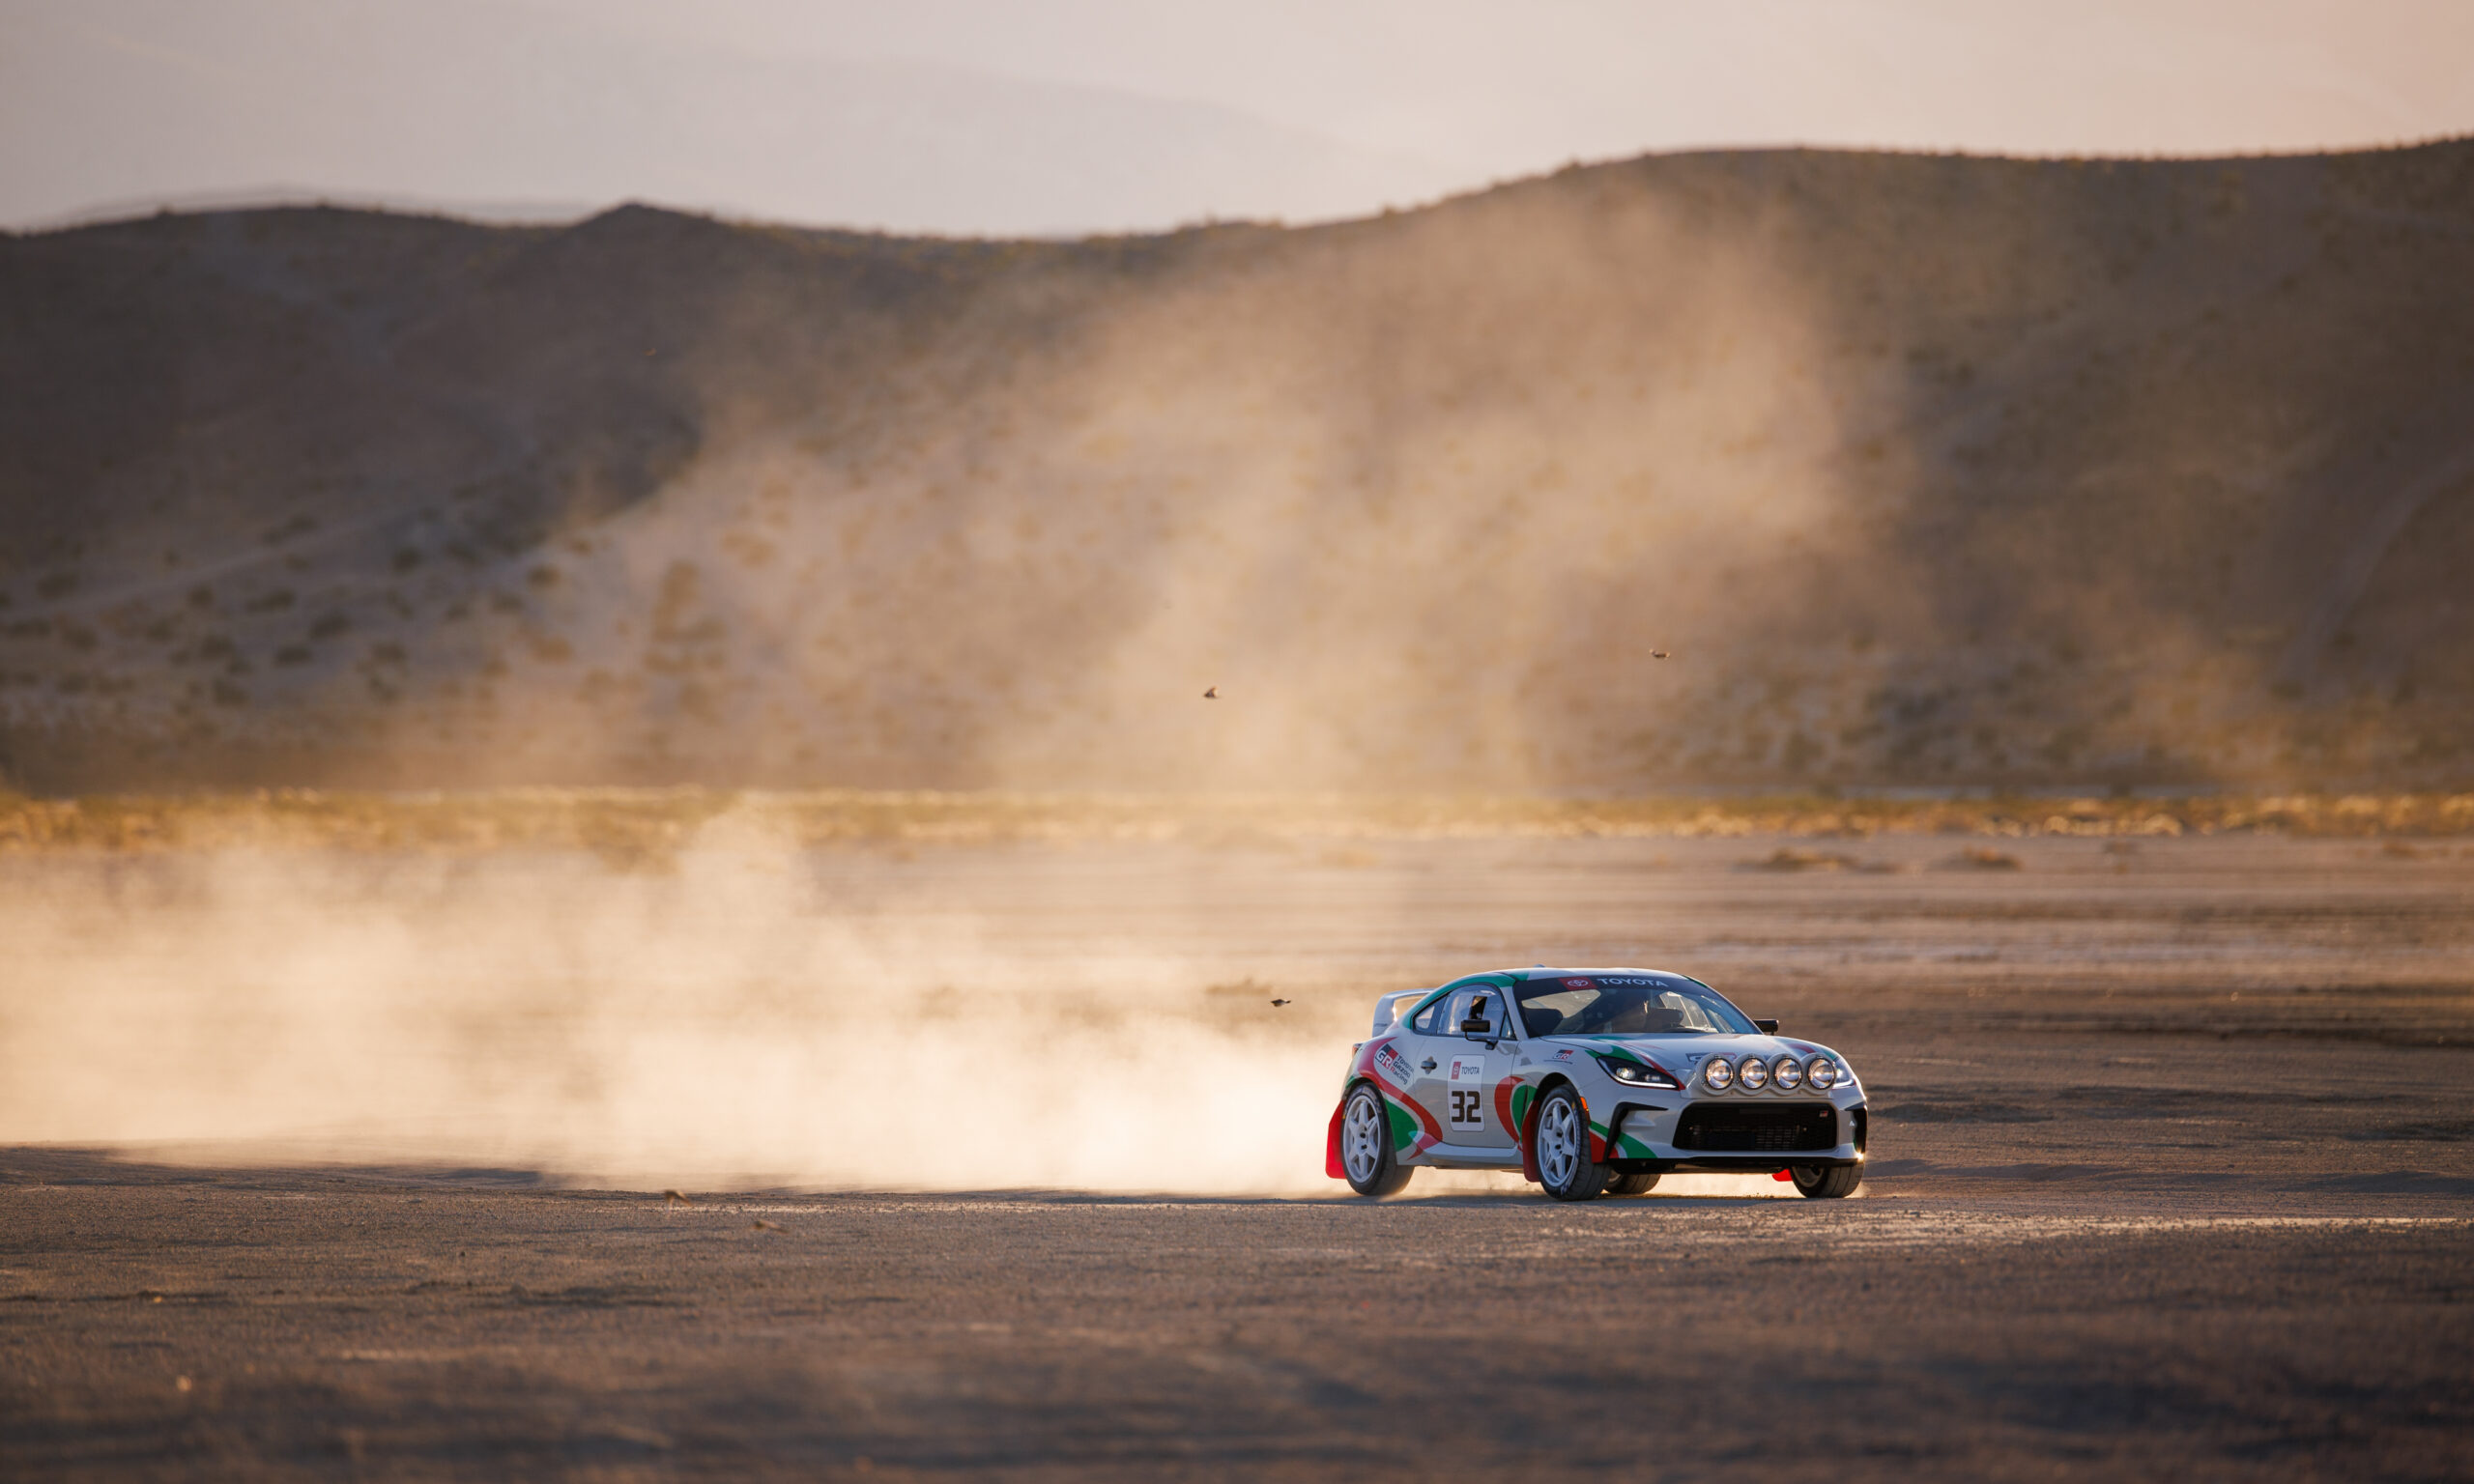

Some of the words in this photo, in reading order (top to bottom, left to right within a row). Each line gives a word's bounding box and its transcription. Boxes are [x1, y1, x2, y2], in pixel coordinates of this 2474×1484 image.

[1597, 978, 1669, 986] TOYOTA
[1375, 1049, 1393, 1069] GR
[1452, 1090, 1482, 1123] 32
